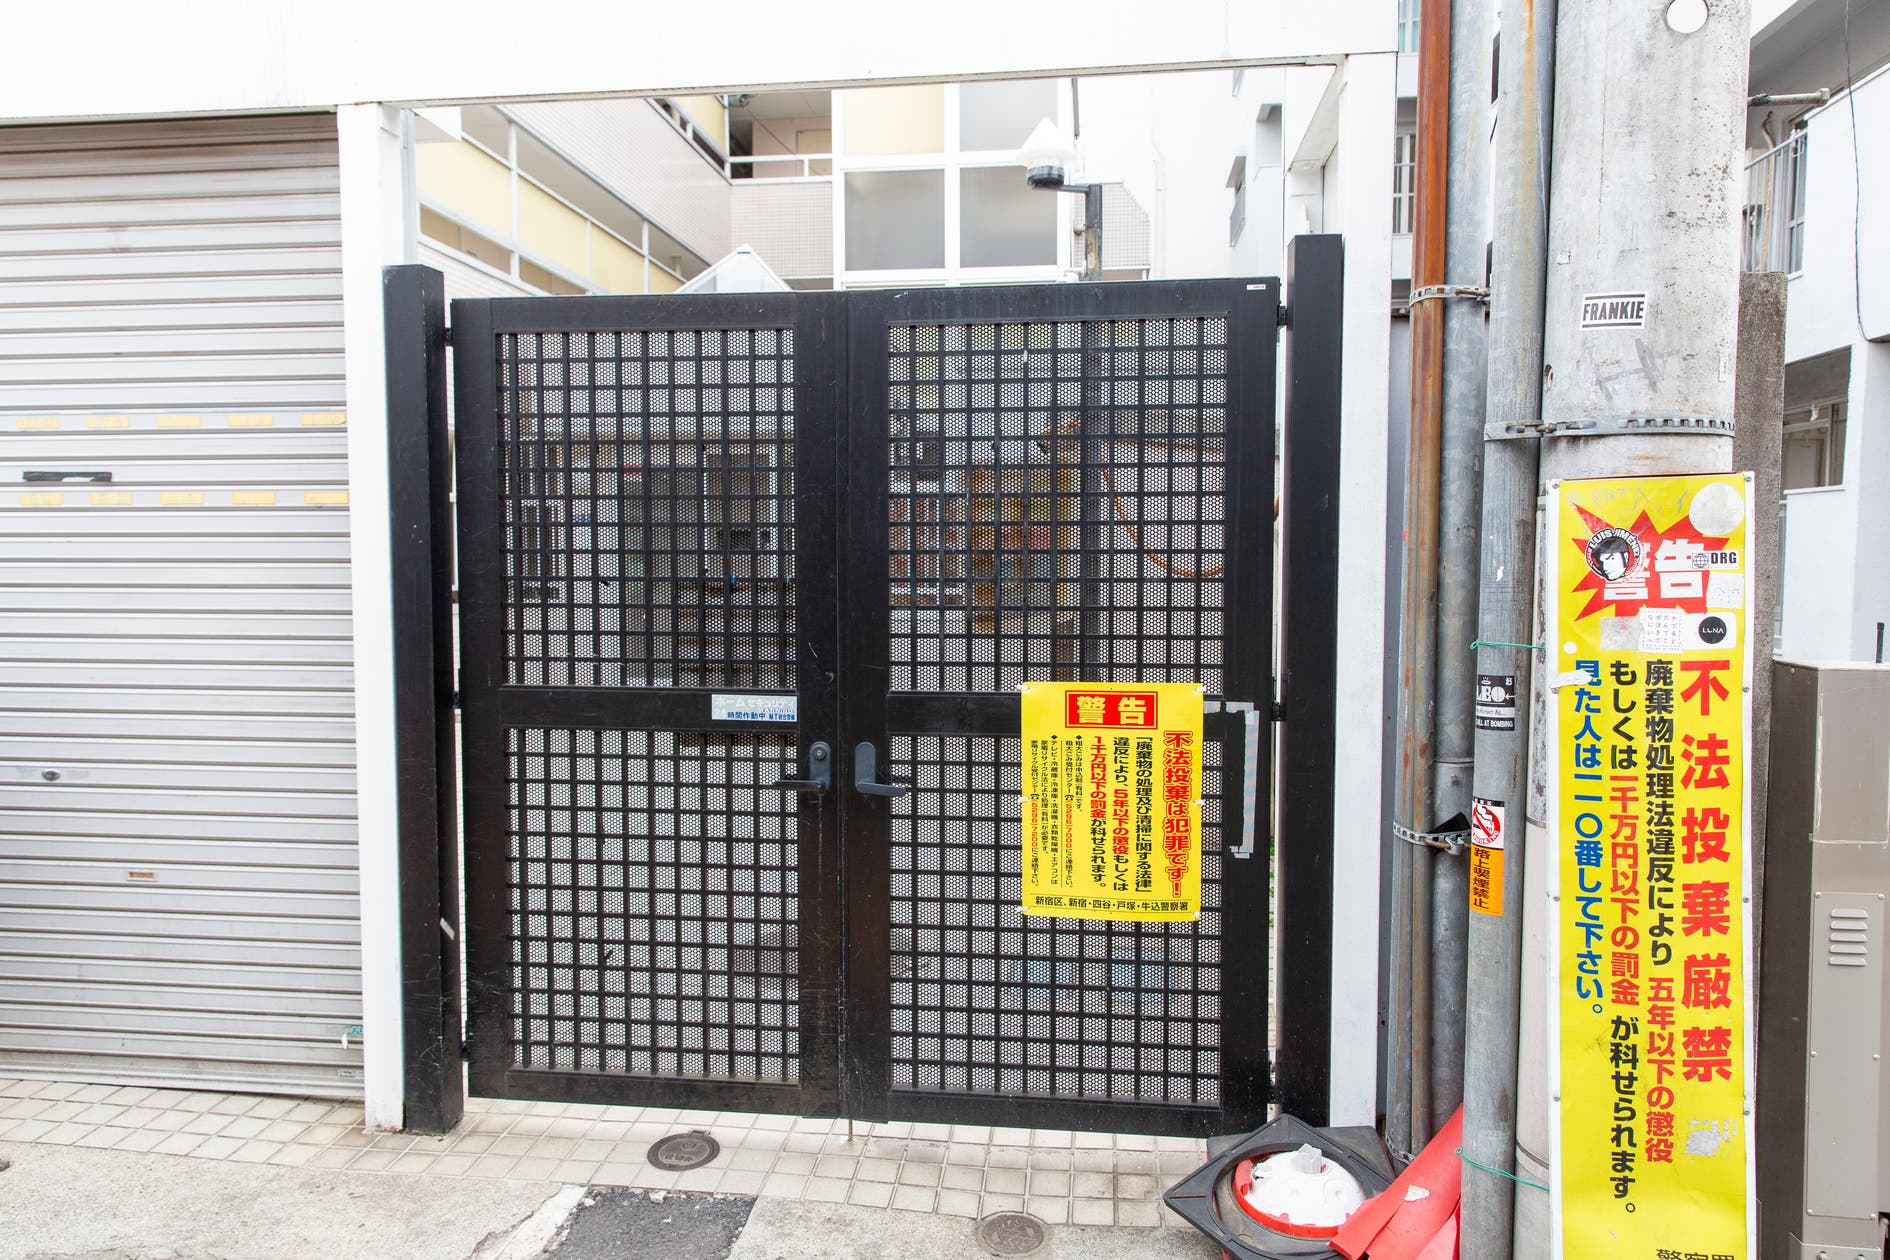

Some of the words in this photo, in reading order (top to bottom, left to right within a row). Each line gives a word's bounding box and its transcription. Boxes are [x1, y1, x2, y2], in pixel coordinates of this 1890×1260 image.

[1583, 301, 1645, 321] FRANKIE
[1589, 529, 1612, 549] LUIS
[1710, 552, 1737, 564] DRG
[1077, 696, 1146, 725] 警告
[1163, 730, 1192, 898] 不法投棄は犯罪です！
[1473, 847, 1491, 910] 路上喫煙禁止
[1680, 659, 1731, 1083] 不法投棄厳禁
